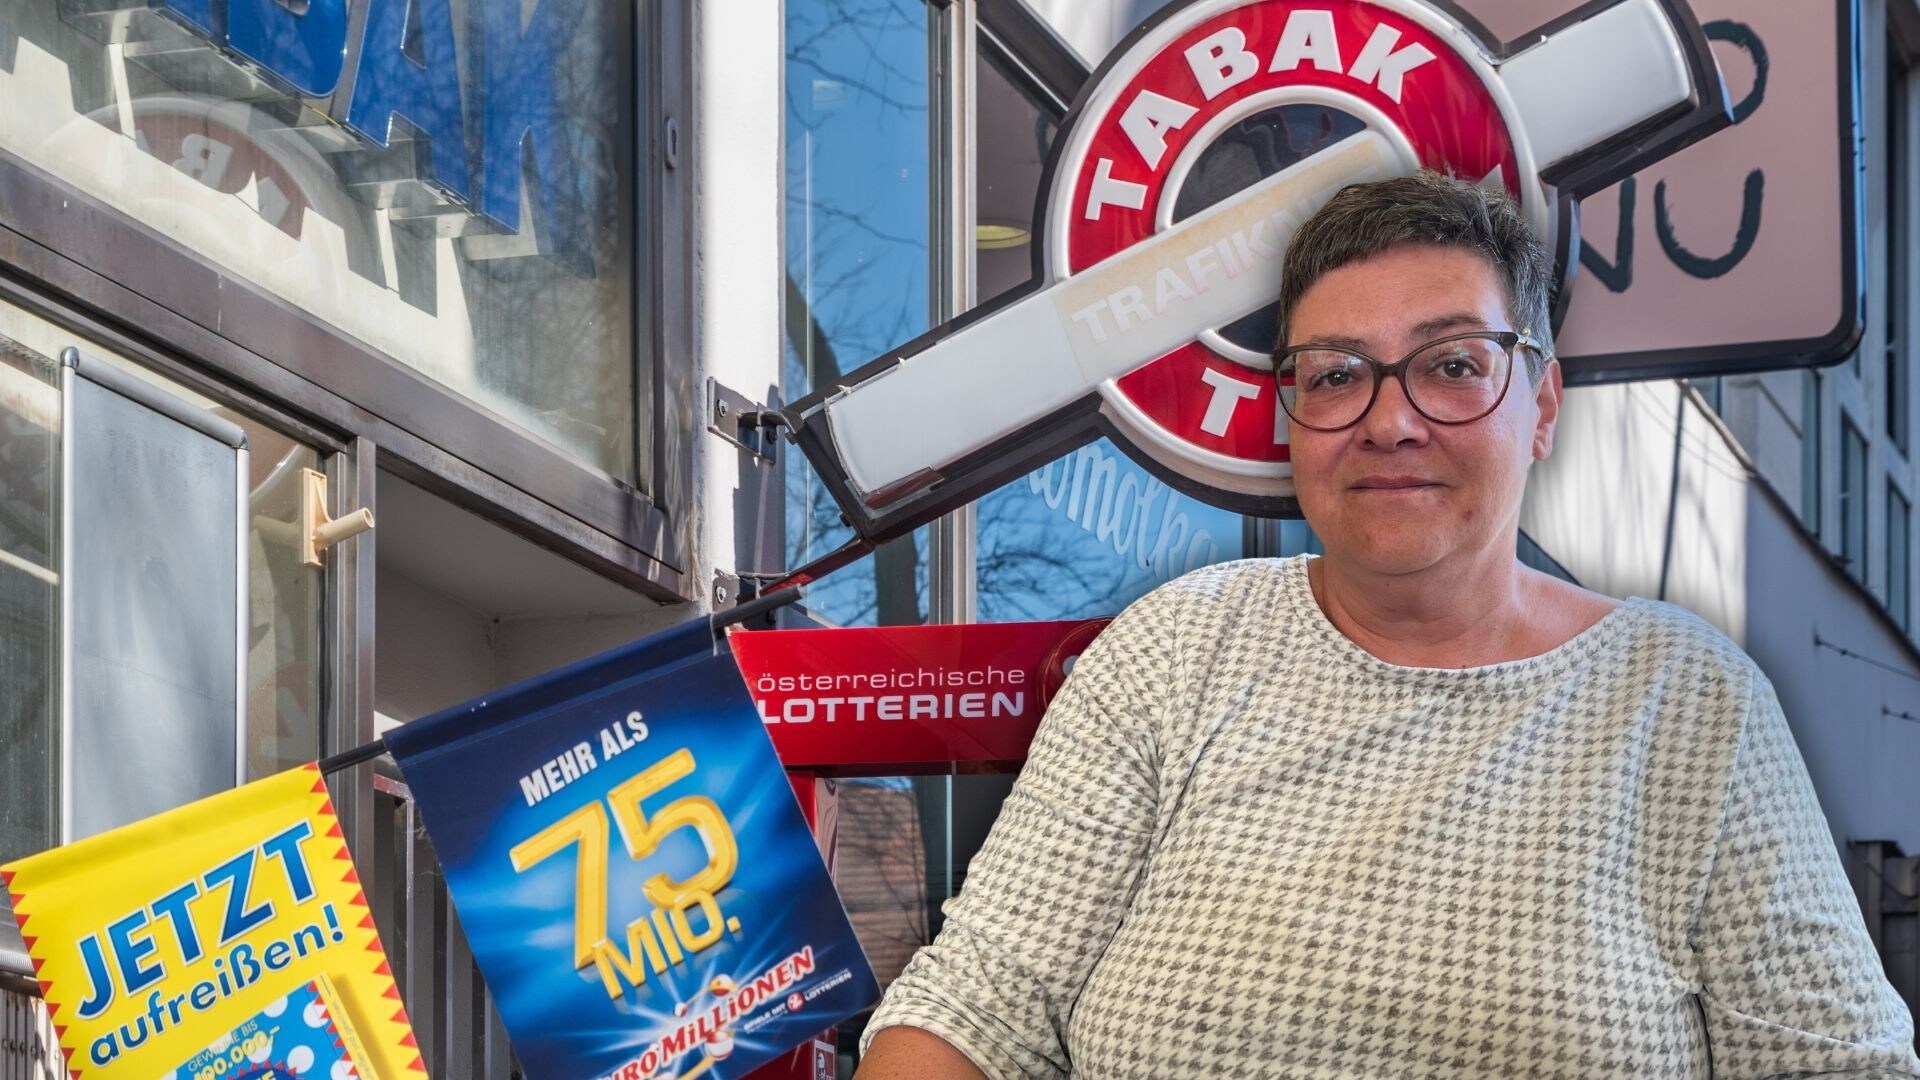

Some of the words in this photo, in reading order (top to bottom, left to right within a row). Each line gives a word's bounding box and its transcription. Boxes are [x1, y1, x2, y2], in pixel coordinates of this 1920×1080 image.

[1085, 9, 1436, 221] TABAK
[757, 665, 1025, 692] österreichische
[757, 691, 1025, 724] LOTTERIEN
[518, 741, 597, 808] MEHR
[601, 711, 649, 763] ALS
[509, 747, 738, 970] 75
[75, 818, 316, 1019] JETZT
[591, 888, 741, 1000] MIO.
[90, 903, 345, 1067] aufreißen!
[241, 1019, 258, 1037] BIS
